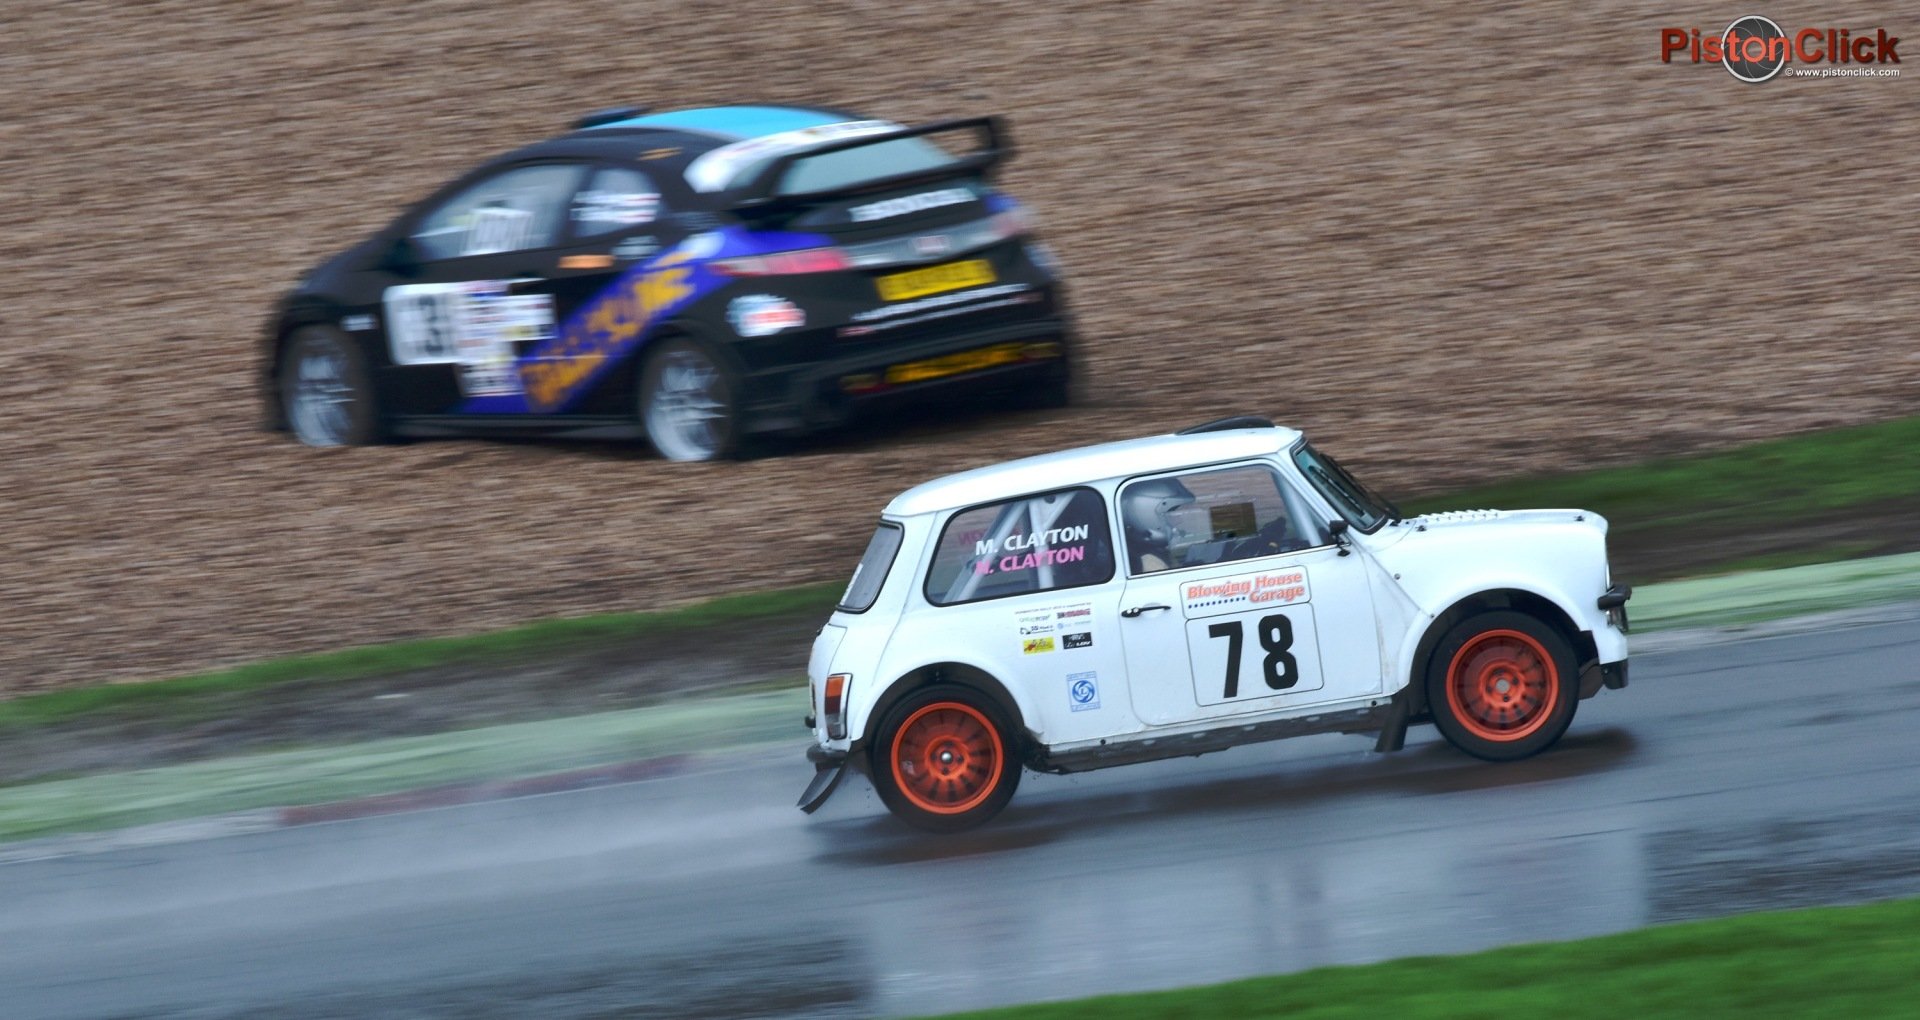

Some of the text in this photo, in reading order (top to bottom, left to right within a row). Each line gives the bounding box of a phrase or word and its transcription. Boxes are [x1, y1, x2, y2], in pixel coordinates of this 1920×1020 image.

[975, 538, 999, 556] M.
[1004, 524, 1089, 552] CLAYTON
[999, 546, 1085, 572] CLAYTON
[1187, 572, 1303, 600] Blowing House
[1249, 585, 1305, 603] Garage
[1208, 614, 1299, 699] 78
